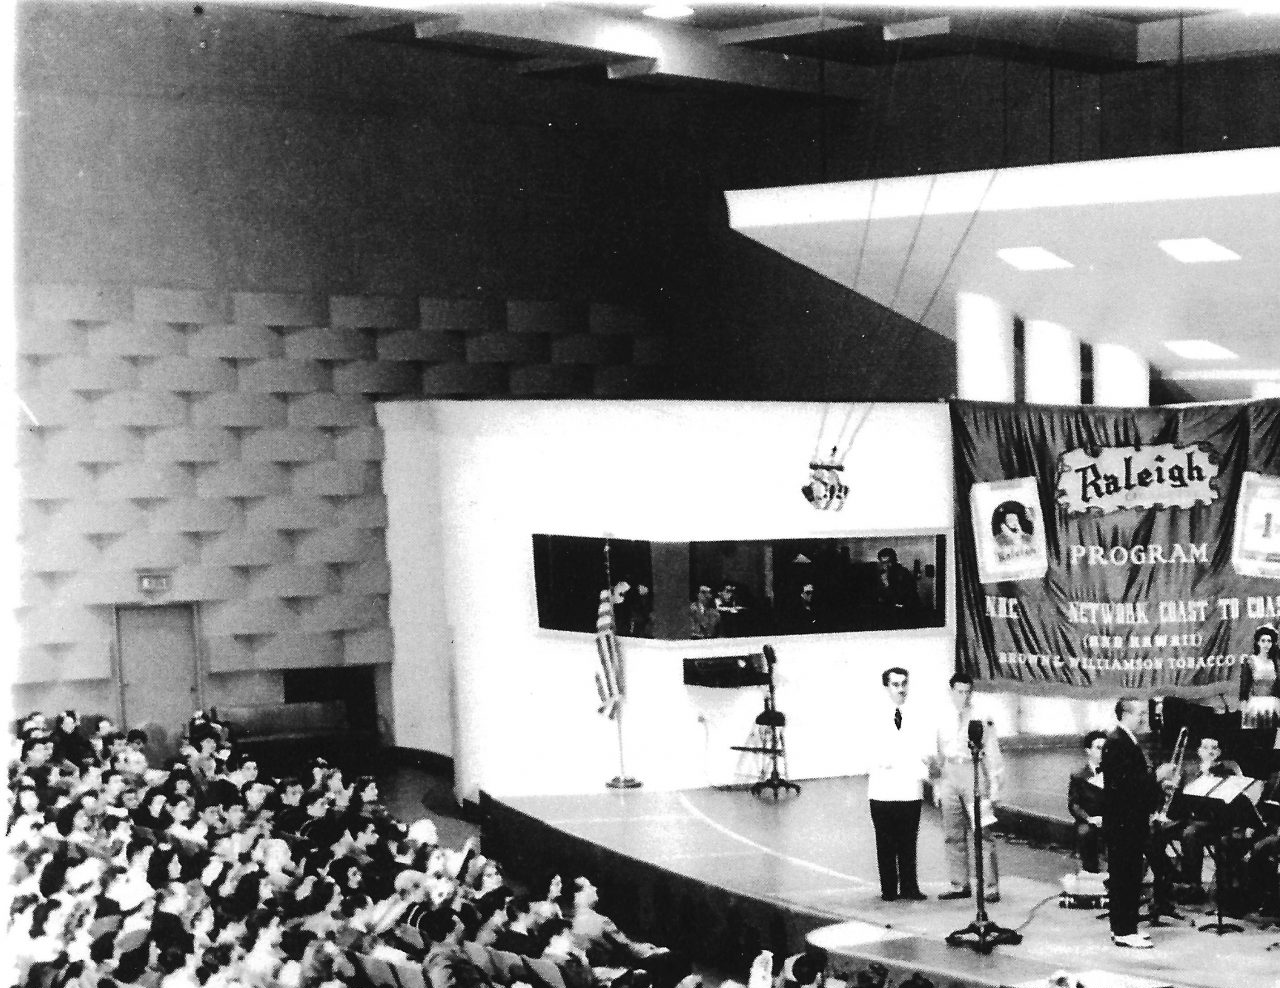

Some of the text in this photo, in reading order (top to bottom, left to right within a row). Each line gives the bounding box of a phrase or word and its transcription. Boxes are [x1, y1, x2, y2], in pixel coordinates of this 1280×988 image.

[1075, 452, 1205, 502] Raleigh
[1070, 543, 1208, 566] PROGRAM
[1068, 601, 1149, 623] NETWORK
[1159, 600, 1208, 622] COAST
[1217, 598, 1239, 620] TO
[1129, 631, 1203, 649] HAWAII)
[999, 651, 1050, 666] BROWN
[1068, 656, 1163, 671] WILLIAMSON
[1168, 654, 1236, 670] TOBACCO
